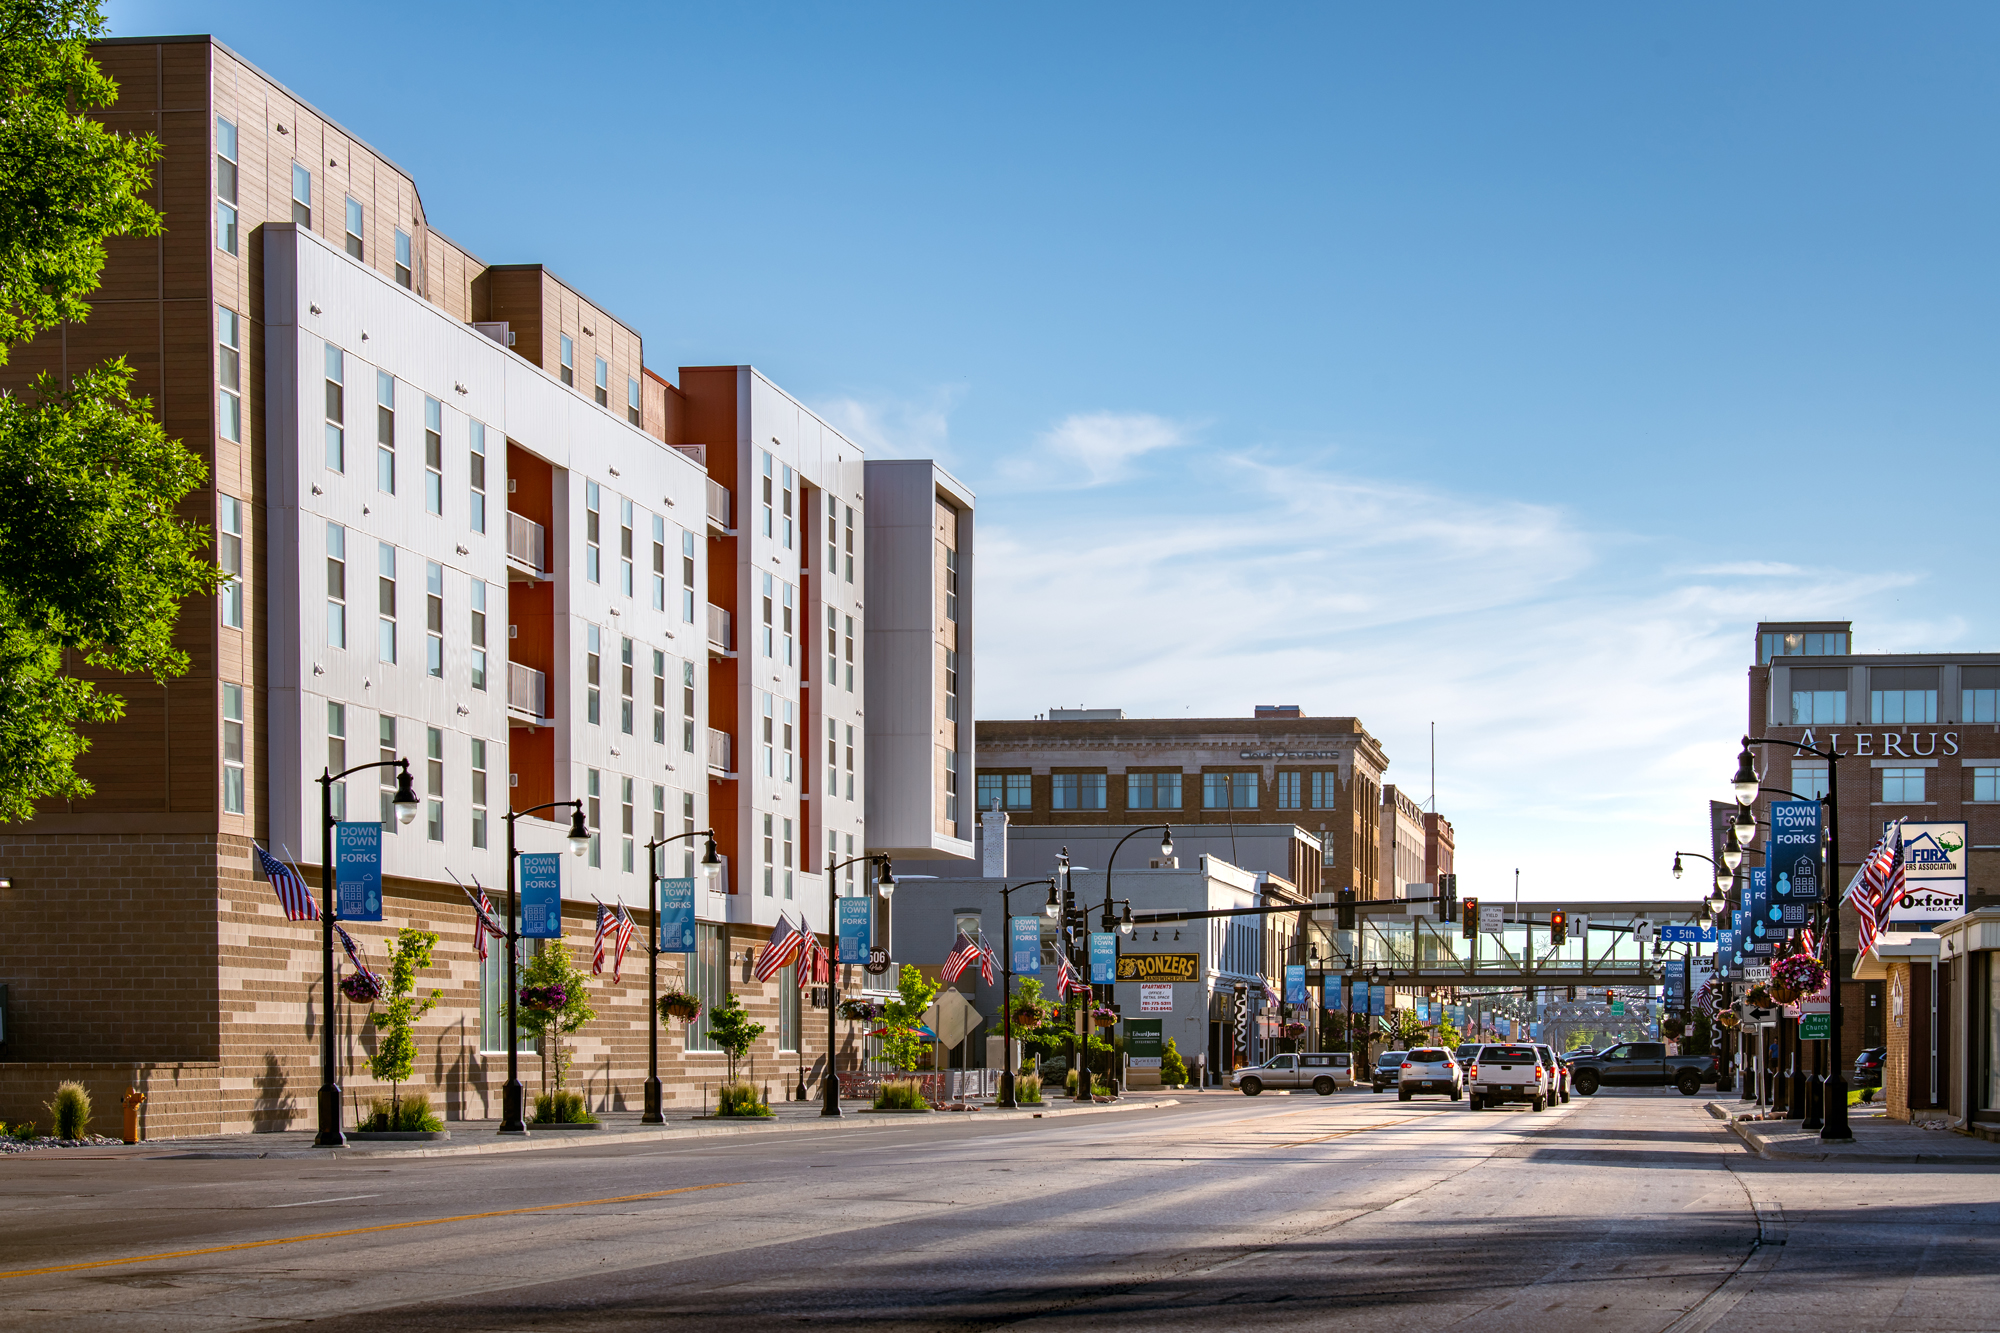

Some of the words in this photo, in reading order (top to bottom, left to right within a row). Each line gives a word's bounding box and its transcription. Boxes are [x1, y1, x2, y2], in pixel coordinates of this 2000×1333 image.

[1793, 729, 1959, 757] ALERUS
[1240, 749, 1272, 760] Cloud
[1286, 750, 1339, 760] EVENTS
[1776, 807, 1816, 816] DOWN
[1776, 817, 1816, 826] TOWN
[341, 827, 377, 836] DOWN
[340, 837, 377, 846] TOWN
[1777, 834, 1816, 844] FORKS
[341, 854, 377, 862] FORKS
[1912, 849, 1951, 864] FORX
[524, 858, 556, 866] DOWN
[524, 866, 556, 874] TOWN
[526, 880, 556, 888] FORKS
[1900, 894, 1964, 909] Oxford
[1666, 929, 1672, 938] S
[1679, 930, 1695, 939] 5th
[1702, 930, 1712, 939] St
[870, 952, 886, 964] 506
[1136, 956, 1195, 976] BONZERS
[1746, 969, 1769, 977] NORTH
